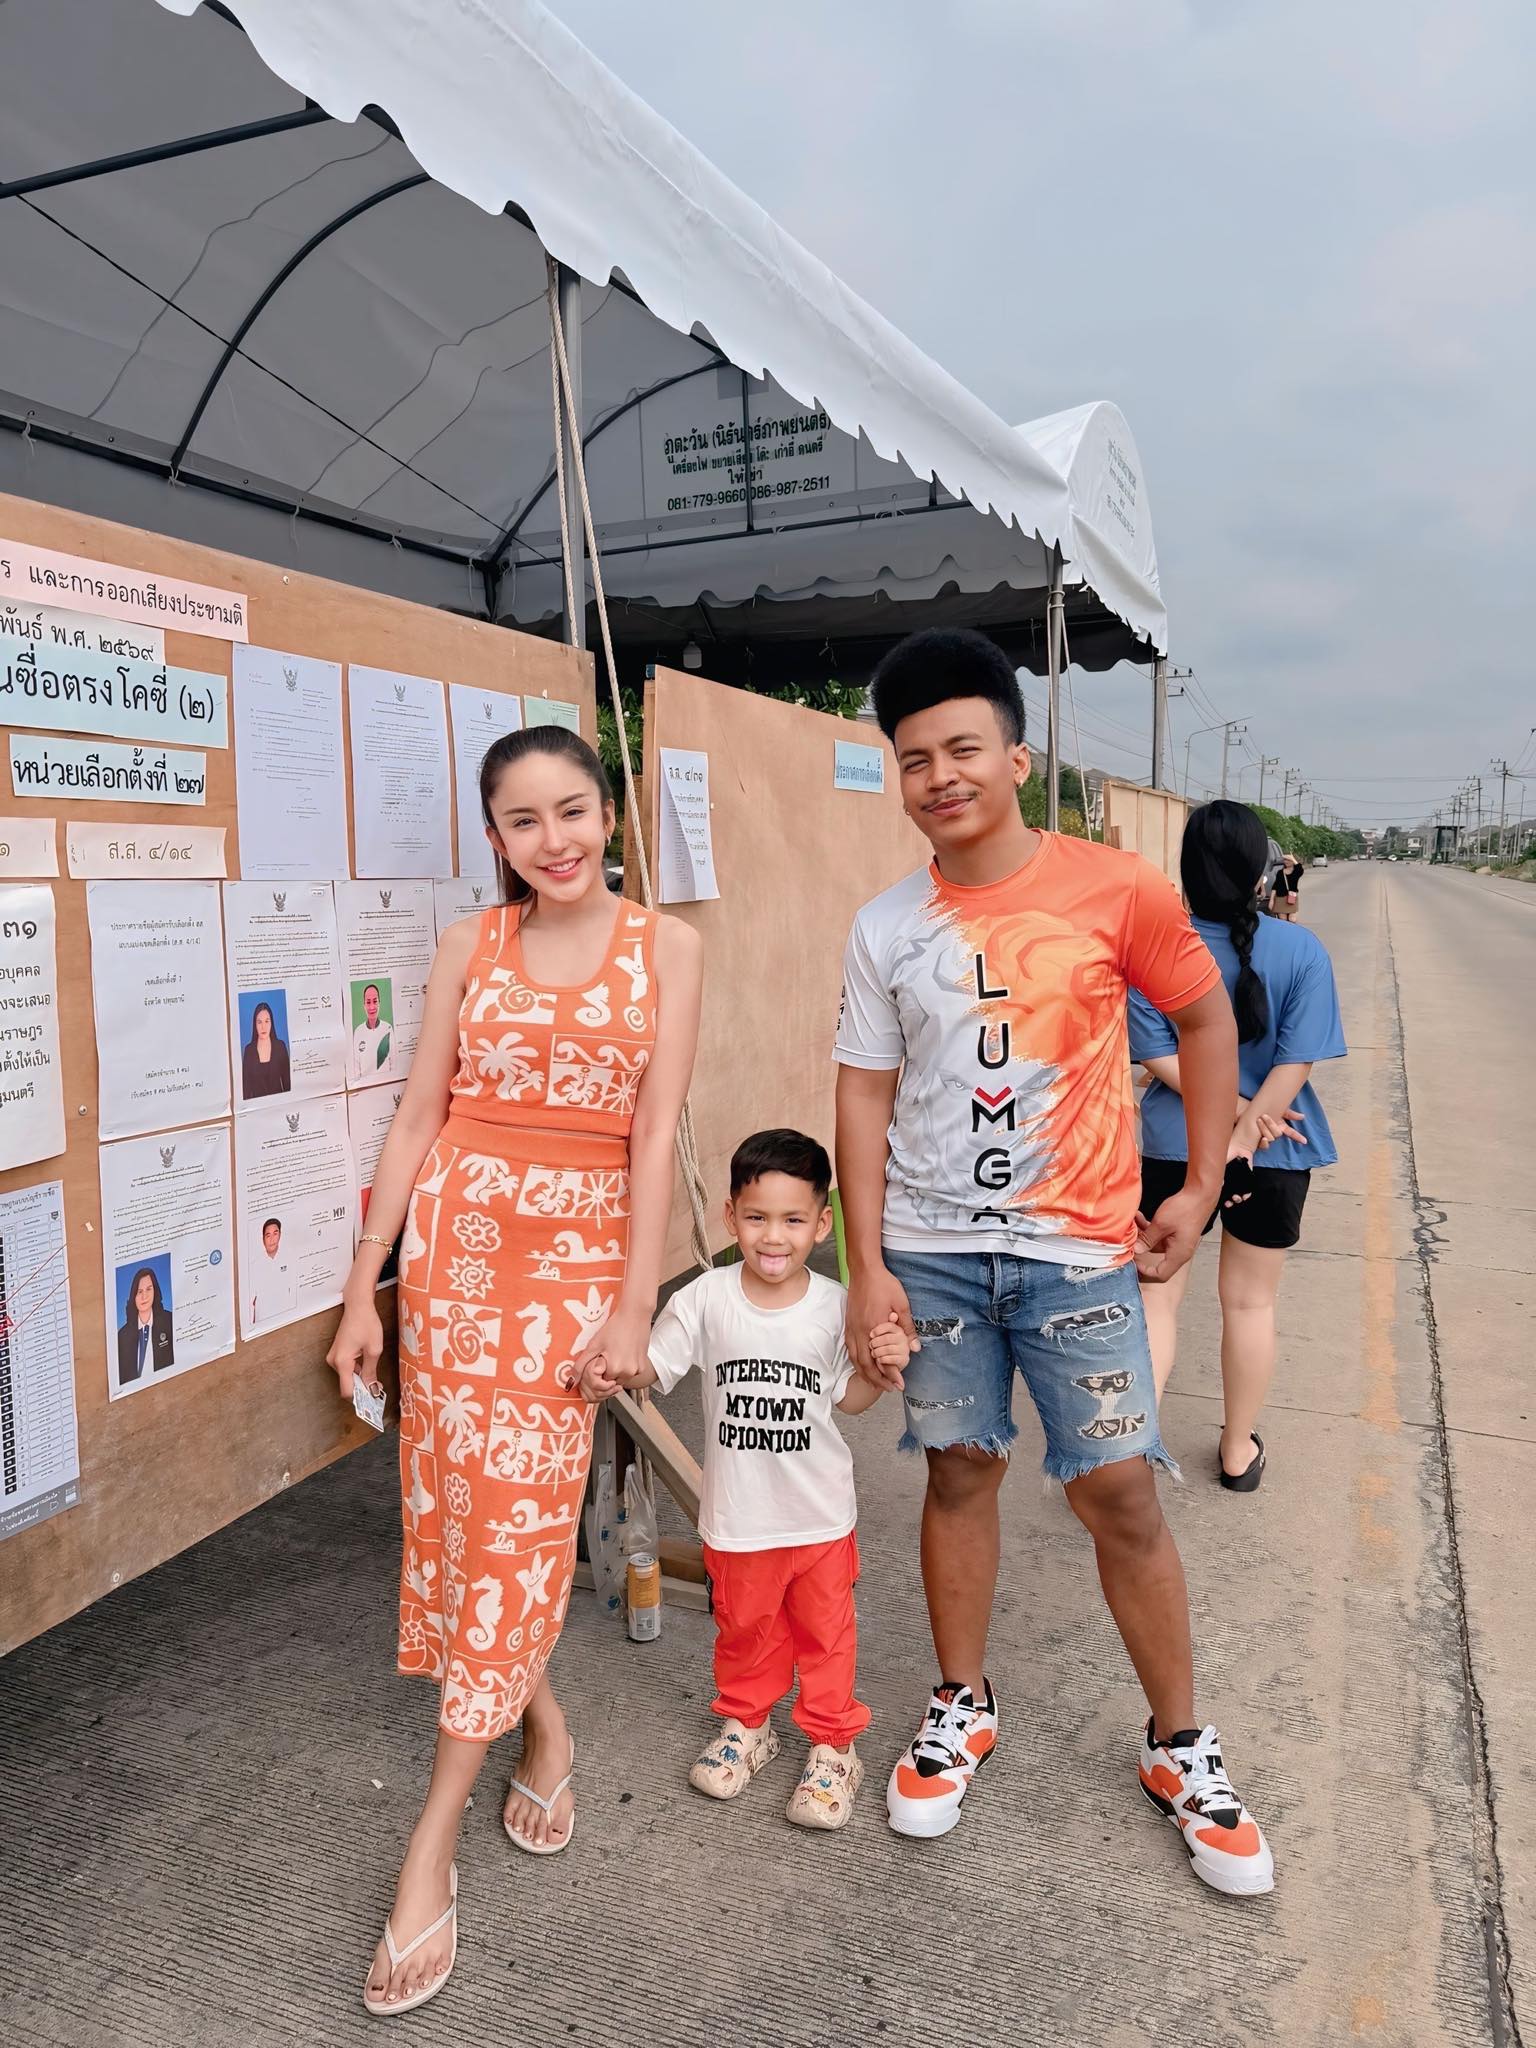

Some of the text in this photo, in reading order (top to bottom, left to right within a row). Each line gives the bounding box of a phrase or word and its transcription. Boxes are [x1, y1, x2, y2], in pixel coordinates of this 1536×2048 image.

[667, 475, 831, 512] 081-779-9660 086-987-2511
[29, 565, 243, 626] และการออกเสียงประชามติ
[50, 625, 92, 650] พ.ศ.
[99, 634, 154, 662] ๒๕๖๙
[179, 685, 214, 724] (๒)
[13, 747, 205, 794] หน่วยเลือกตั้งที่ ๒๗
[107, 841, 193, 861] ส.ส. ๔/๑๔
[715, 1358, 821, 1395] INTERESTING
[719, 1421, 811, 1454] OPIONION
